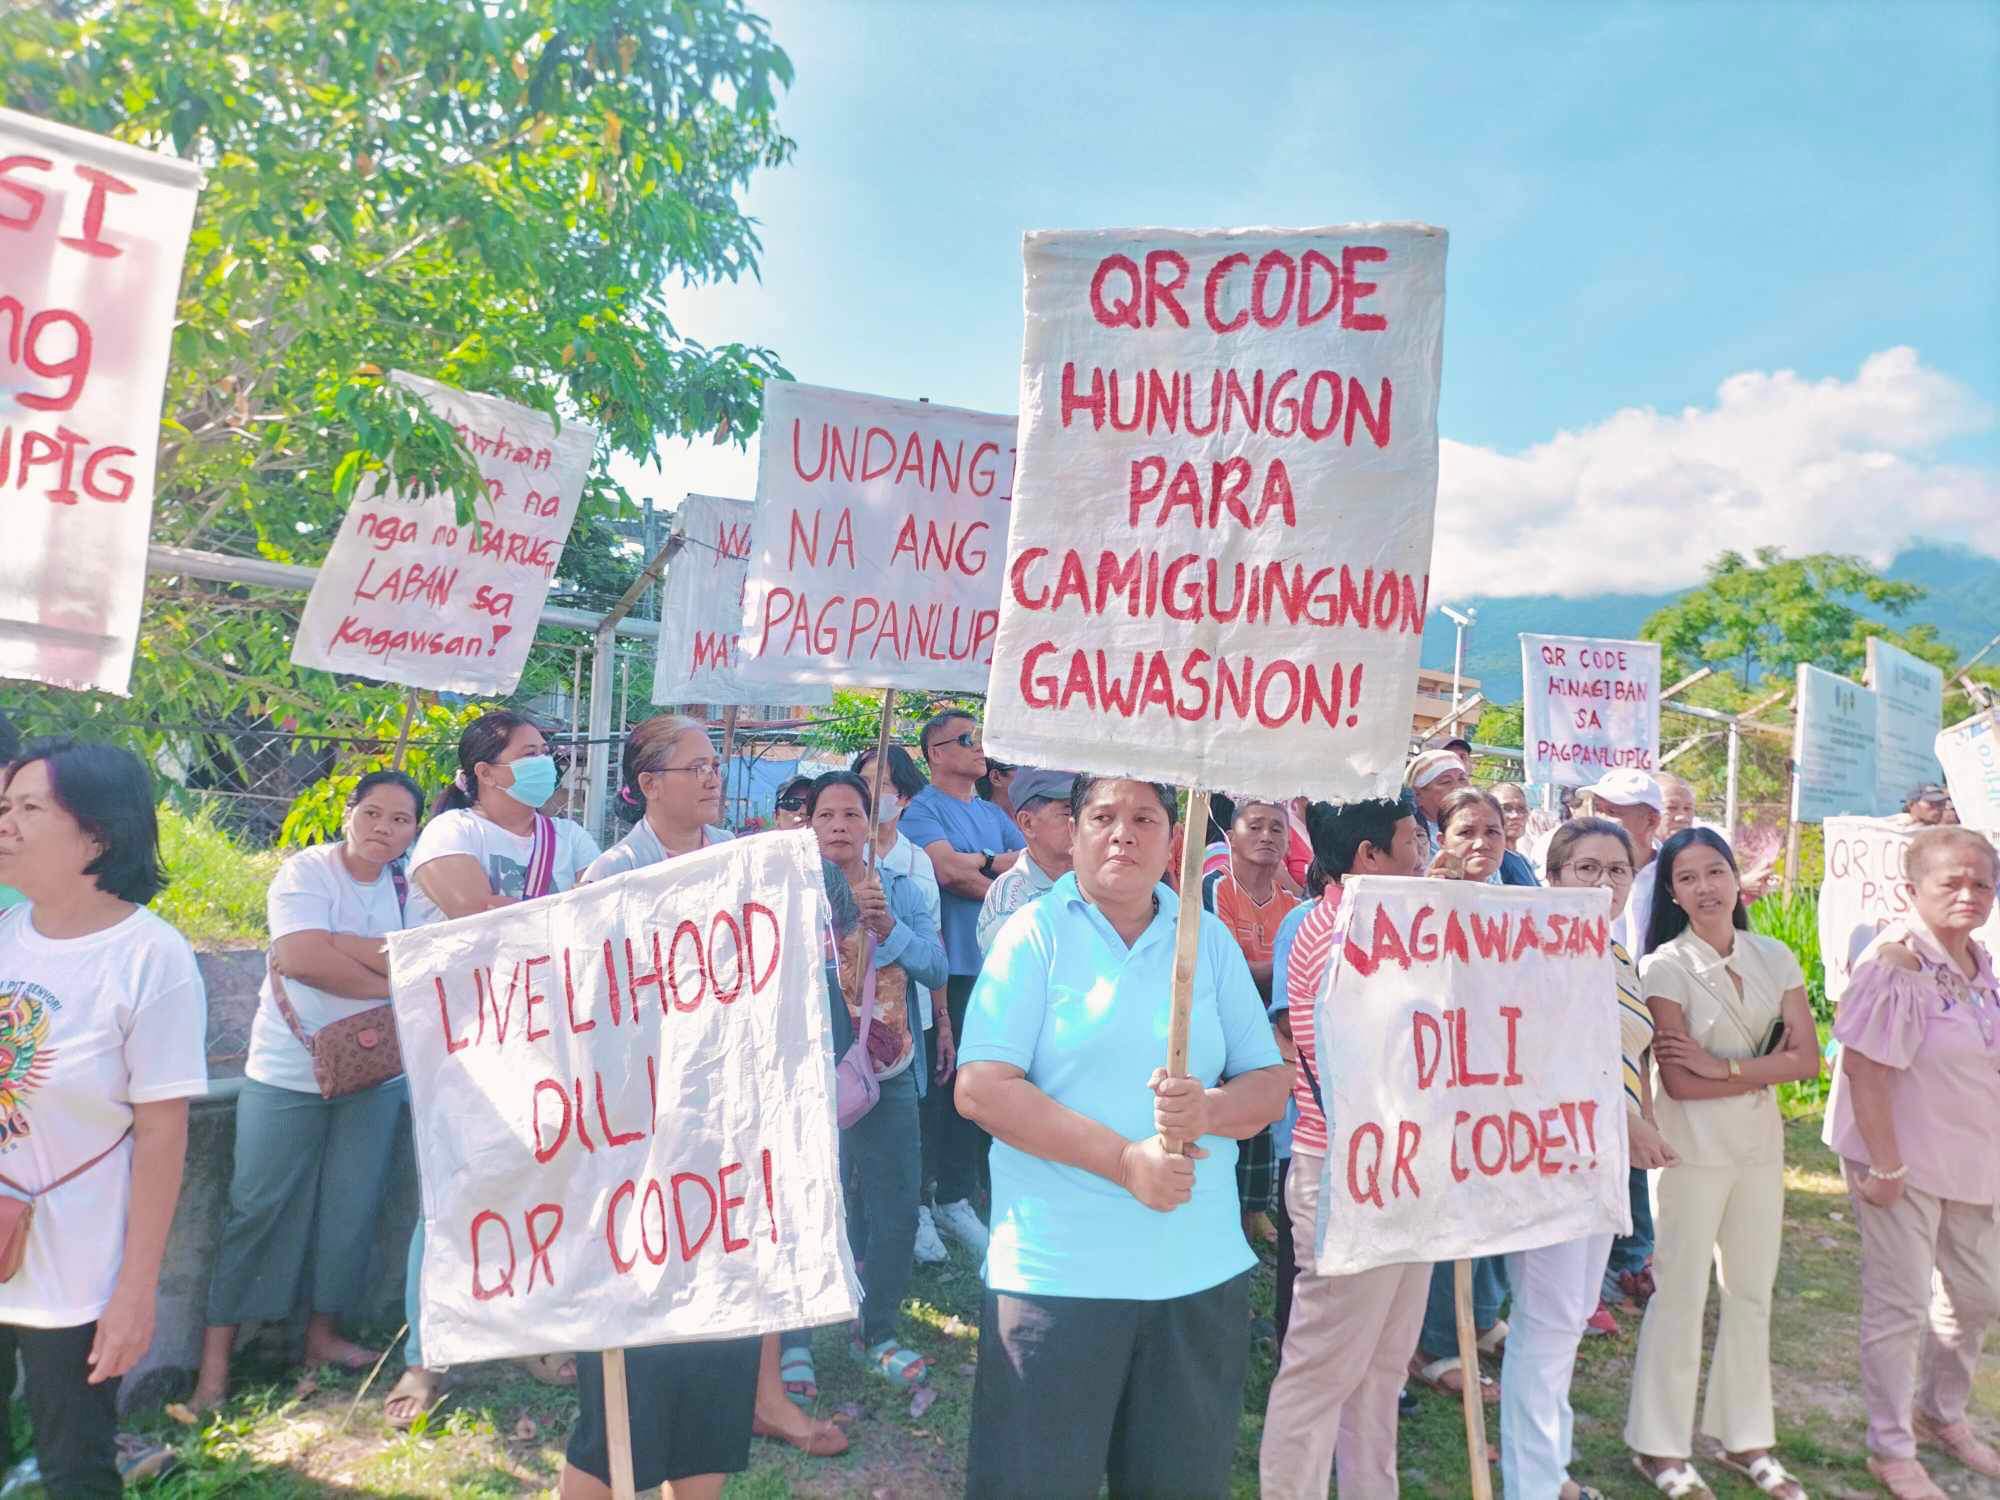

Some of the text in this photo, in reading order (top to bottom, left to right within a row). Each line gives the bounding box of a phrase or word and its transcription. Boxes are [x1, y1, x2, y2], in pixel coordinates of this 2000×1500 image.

[1090, 246, 1388, 334] QR CODE
[1061, 362, 1393, 449] HUNUNGON
[356, 511, 417, 551] nga
[1129, 456, 1297, 529] PARA
[788, 507, 990, 577] NA ANG
[353, 557, 514, 619] LABAN sa
[759, 587, 1000, 665] PAGPANLUP
[1010, 546, 1428, 636] CAMIGUINGNON
[1019, 640, 1363, 729] GAWASNON!
[1541, 645, 1628, 671] QR CODE
[1575, 707, 1602, 729] SA
[1831, 839, 1869, 879] QR
[434, 902, 781, 1055] LIVELIHOOD
[1412, 1006, 1524, 1089] DILI
[533, 1055, 658, 1164] DILI
[1346, 1099, 1599, 1208] QR CODE!!
[470, 1148, 778, 1301] QR CODE!
